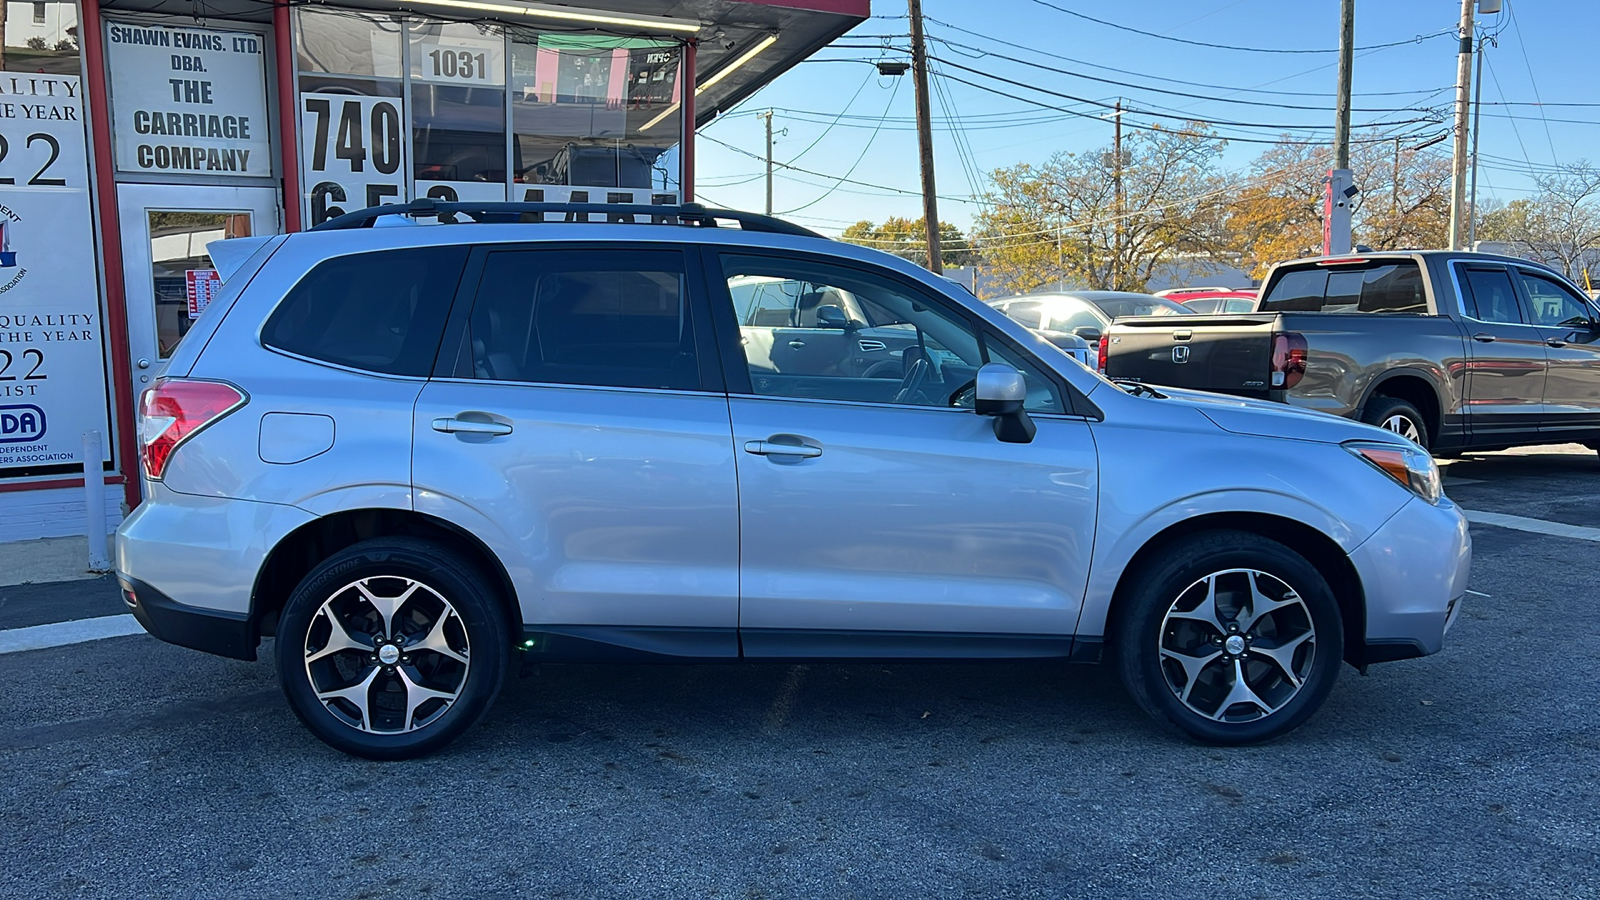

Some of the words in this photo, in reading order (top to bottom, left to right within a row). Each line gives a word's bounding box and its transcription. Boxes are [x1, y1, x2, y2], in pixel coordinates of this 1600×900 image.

[110, 27, 169, 47] SHAWN
[173, 32, 226, 51] EVANS.
[232, 37, 261, 54] LTD.
[171, 54, 207, 72] DBA.
[429, 49, 486, 79] 1031
[169, 78, 213, 104] THE
[20, 104, 77, 121] YEAR
[134, 110, 250, 139] CARRIAGE
[305, 98, 400, 175] 740
[137, 144, 250, 172] COMPANY
[43, 330, 92, 342] YEAR
[16, 453, 74, 463] ASSOCIATION
